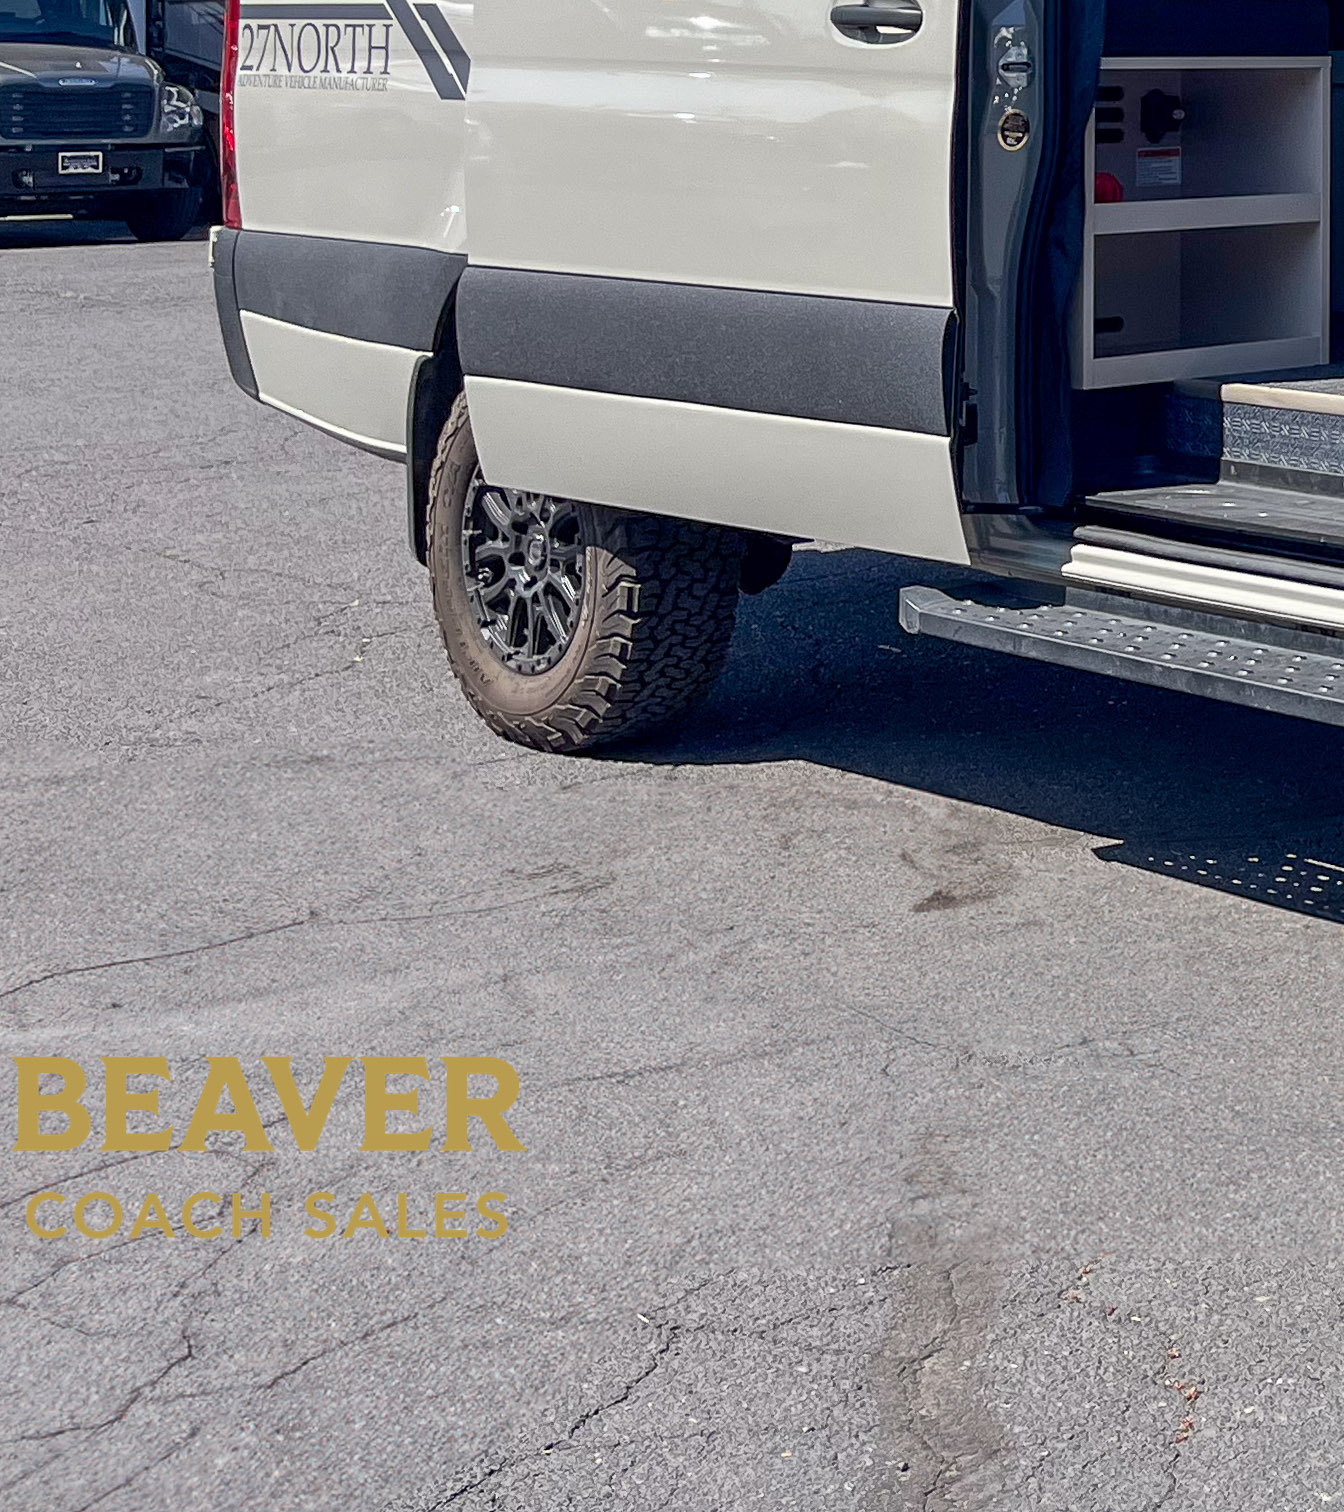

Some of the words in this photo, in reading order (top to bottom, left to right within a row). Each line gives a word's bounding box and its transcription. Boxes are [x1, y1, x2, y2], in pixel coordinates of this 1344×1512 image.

[239, 22, 394, 75] 27NORTH
[238, 74, 284, 89] ADVENTURE
[284, 74, 318, 90] VEHICLE
[319, 75, 388, 93] MANUFACTURER
